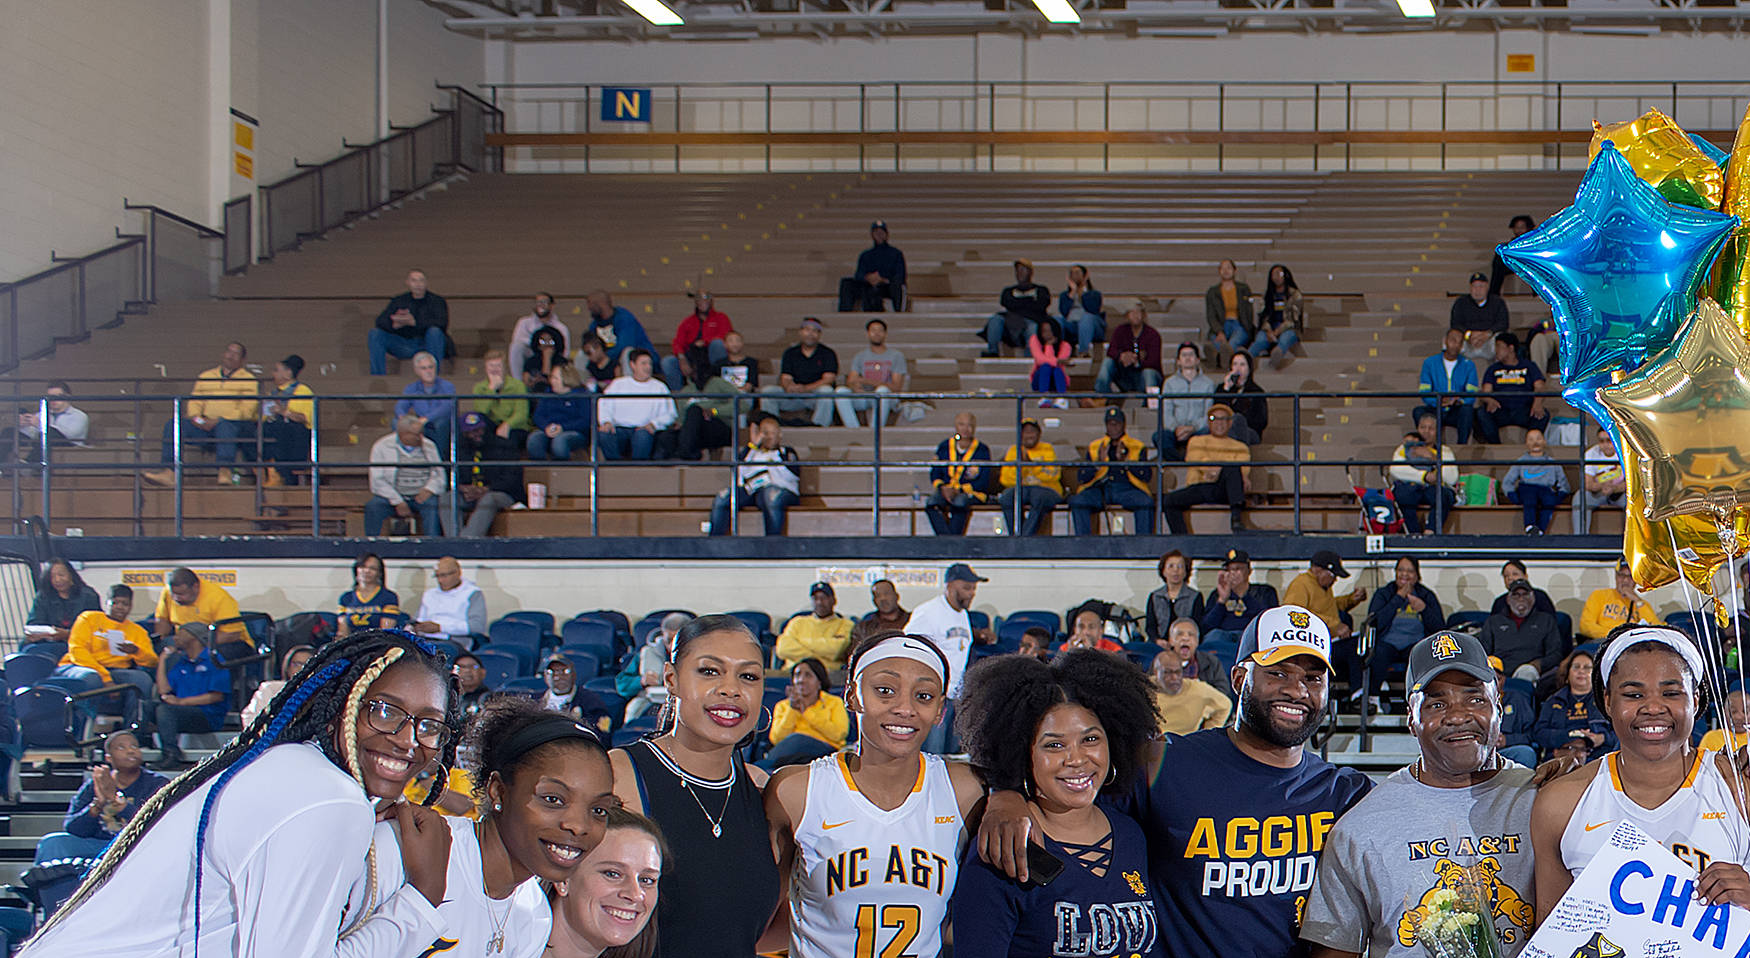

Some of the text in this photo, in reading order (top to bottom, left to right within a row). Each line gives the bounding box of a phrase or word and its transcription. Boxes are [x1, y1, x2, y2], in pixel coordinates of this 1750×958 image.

[615, 91, 640, 118] N
[1270, 630, 1325, 650] AGGIES
[1408, 833, 1520, 861] NC A&T
[827, 844, 949, 898] NC A&T
[1202, 855, 1316, 897] PROUD
